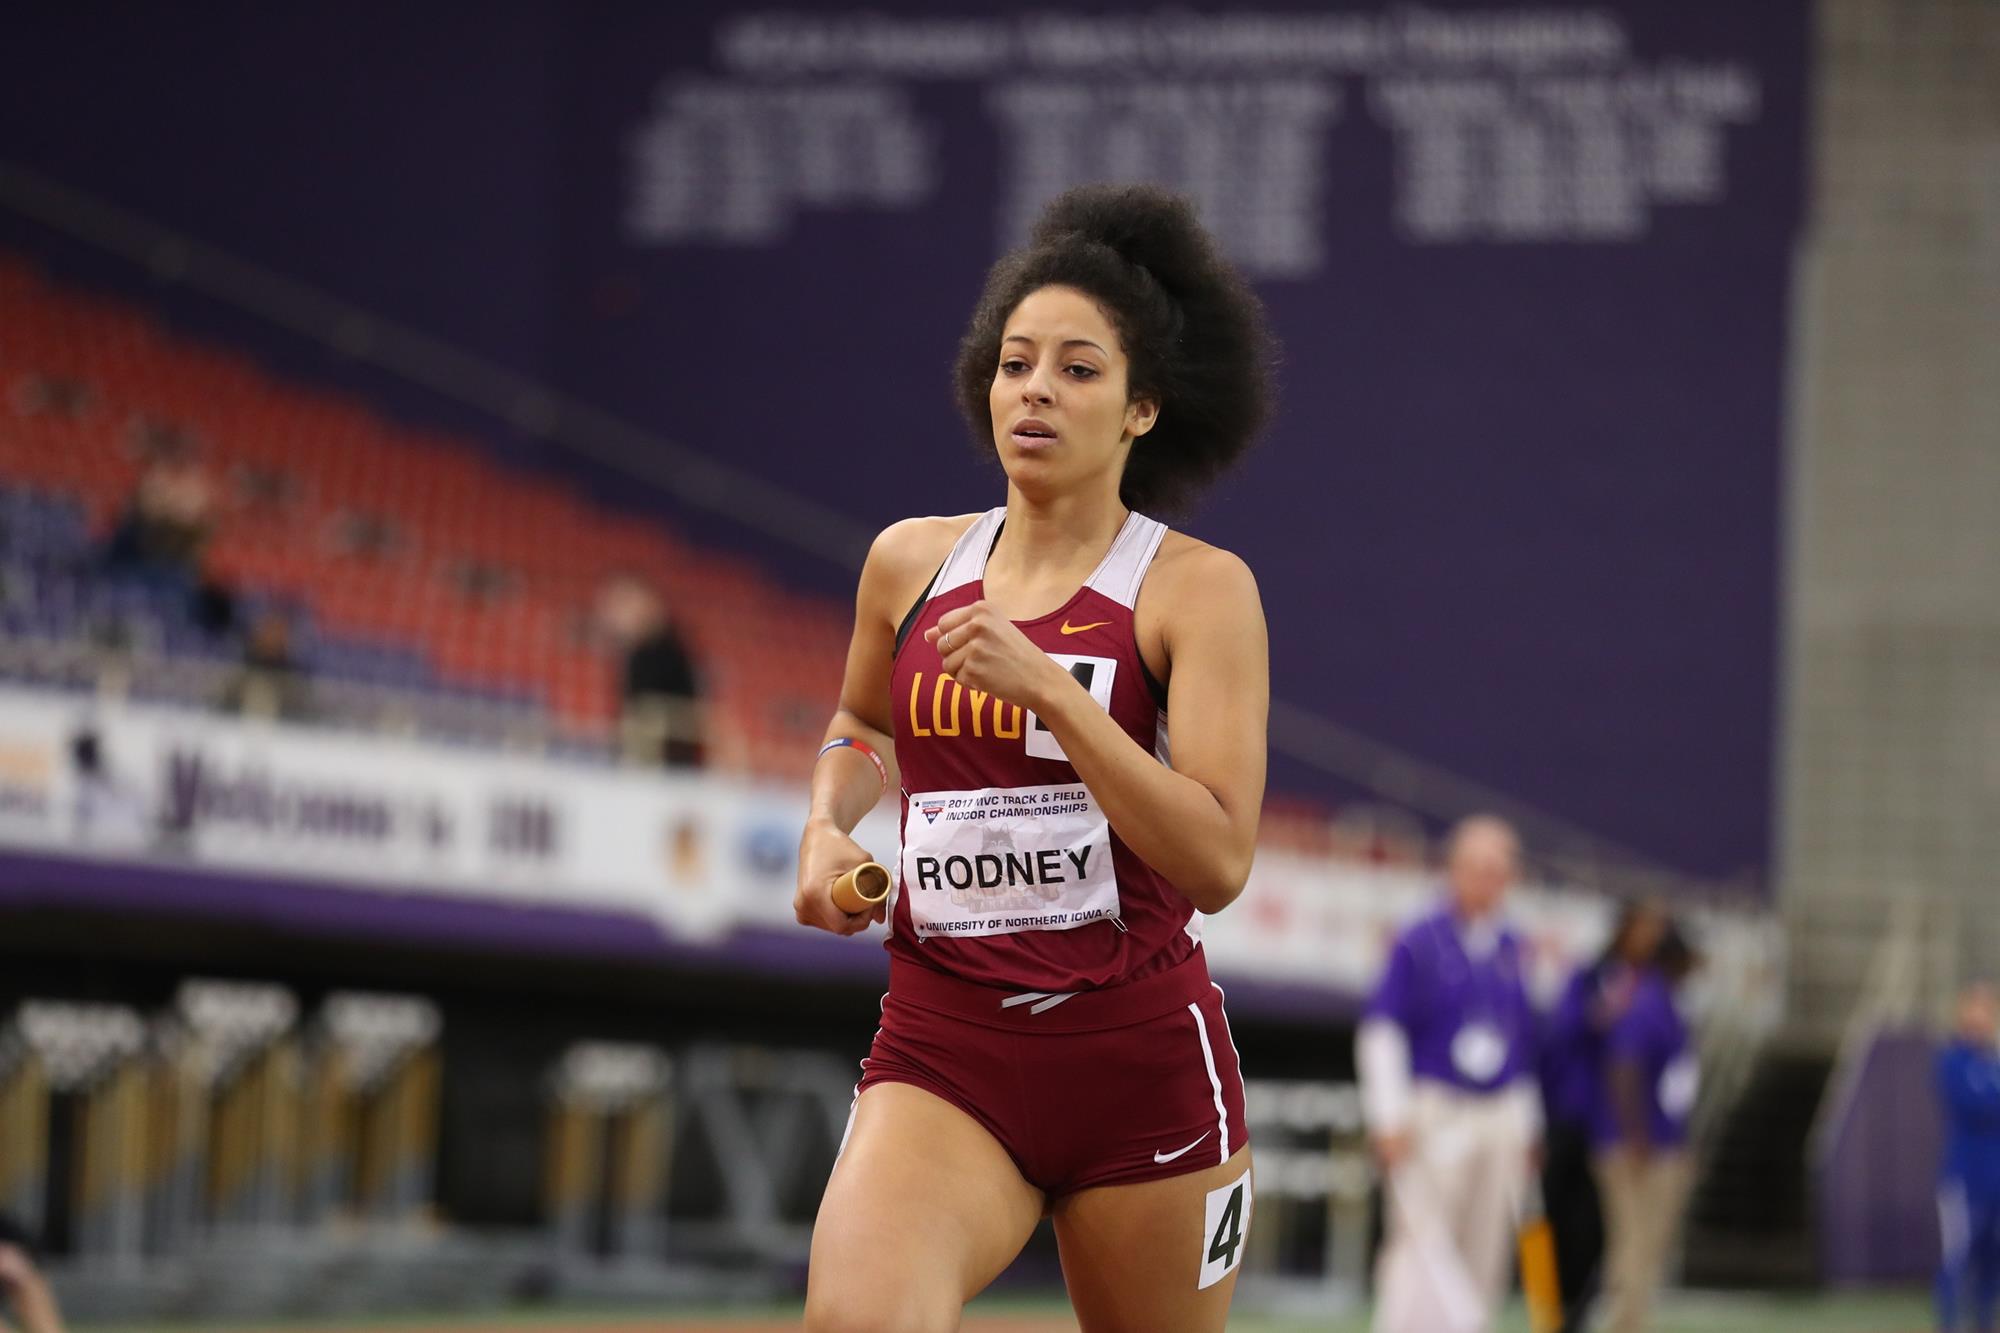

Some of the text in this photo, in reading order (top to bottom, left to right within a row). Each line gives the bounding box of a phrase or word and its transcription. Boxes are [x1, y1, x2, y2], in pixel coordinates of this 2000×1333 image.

[948, 798, 974, 809] 2017
[1003, 794, 1037, 805] TRACK
[1041, 793, 1049, 803] &
[1053, 791, 1086, 801] FIELD
[946, 810, 986, 821] INDOOR
[989, 802, 1088, 819] CHAMPIONSHIPS
[916, 845, 1092, 890] RODNEY
[926, 909, 1102, 931] UNIVERSITY OF NORTHERN IOWA
[1207, 1183, 1242, 1270] 4
